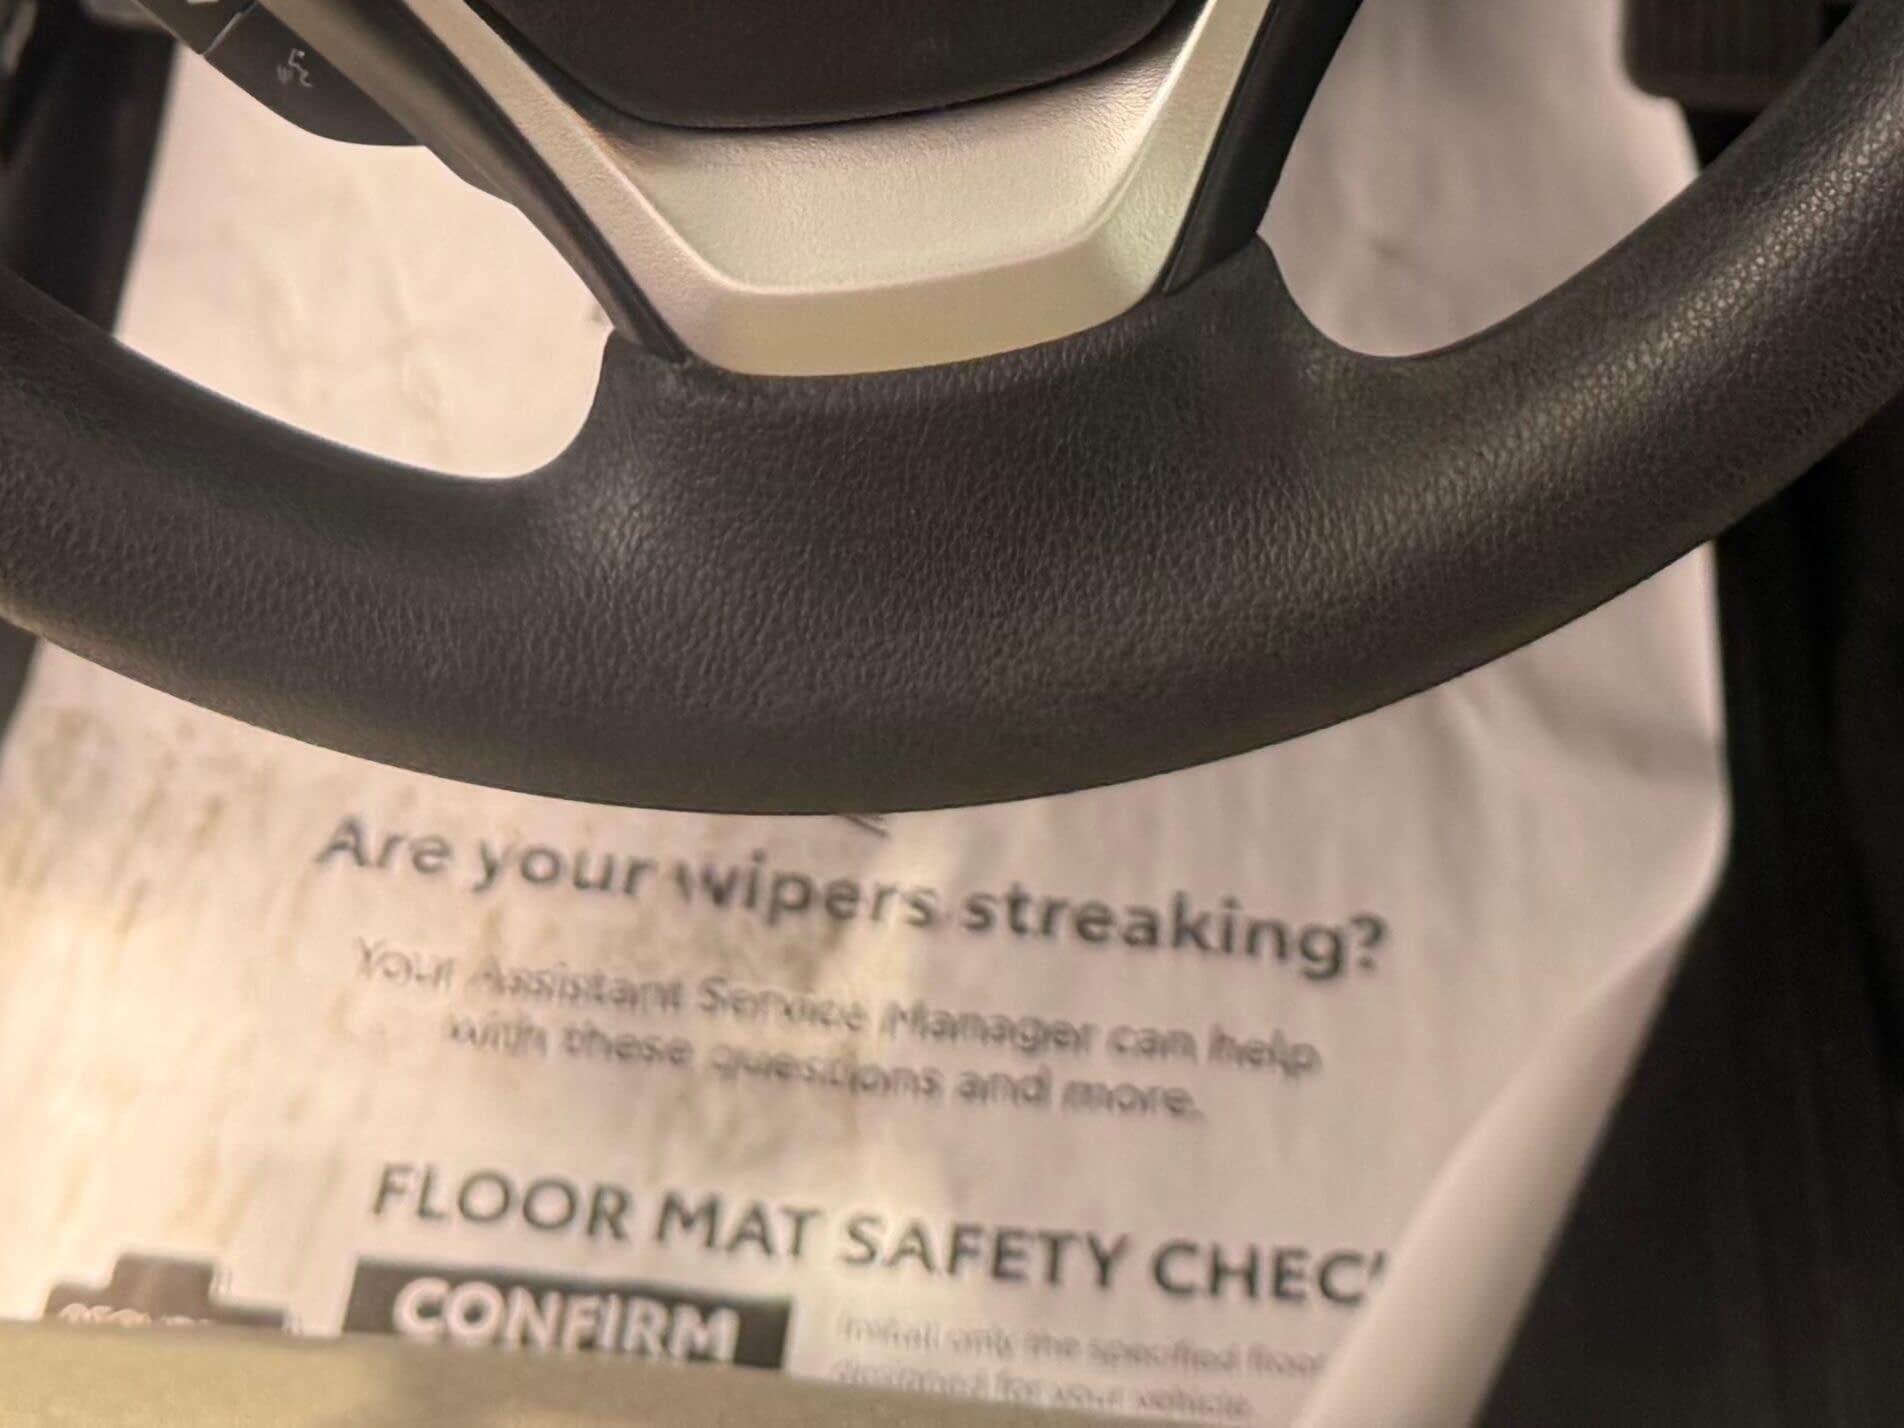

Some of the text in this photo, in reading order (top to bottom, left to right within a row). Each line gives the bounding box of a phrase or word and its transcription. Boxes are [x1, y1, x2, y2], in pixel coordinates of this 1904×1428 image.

[313, 814, 1389, 984] Are your wipers streaking?
[356, 936, 1323, 1078] Your Assistant Service Manager can help
[449, 1014, 1206, 1125] with these questions and more.
[371, 1162, 1387, 1308] FLOOR MAT SAFETY CHEC
[395, 1277, 740, 1362] CONFIRM
